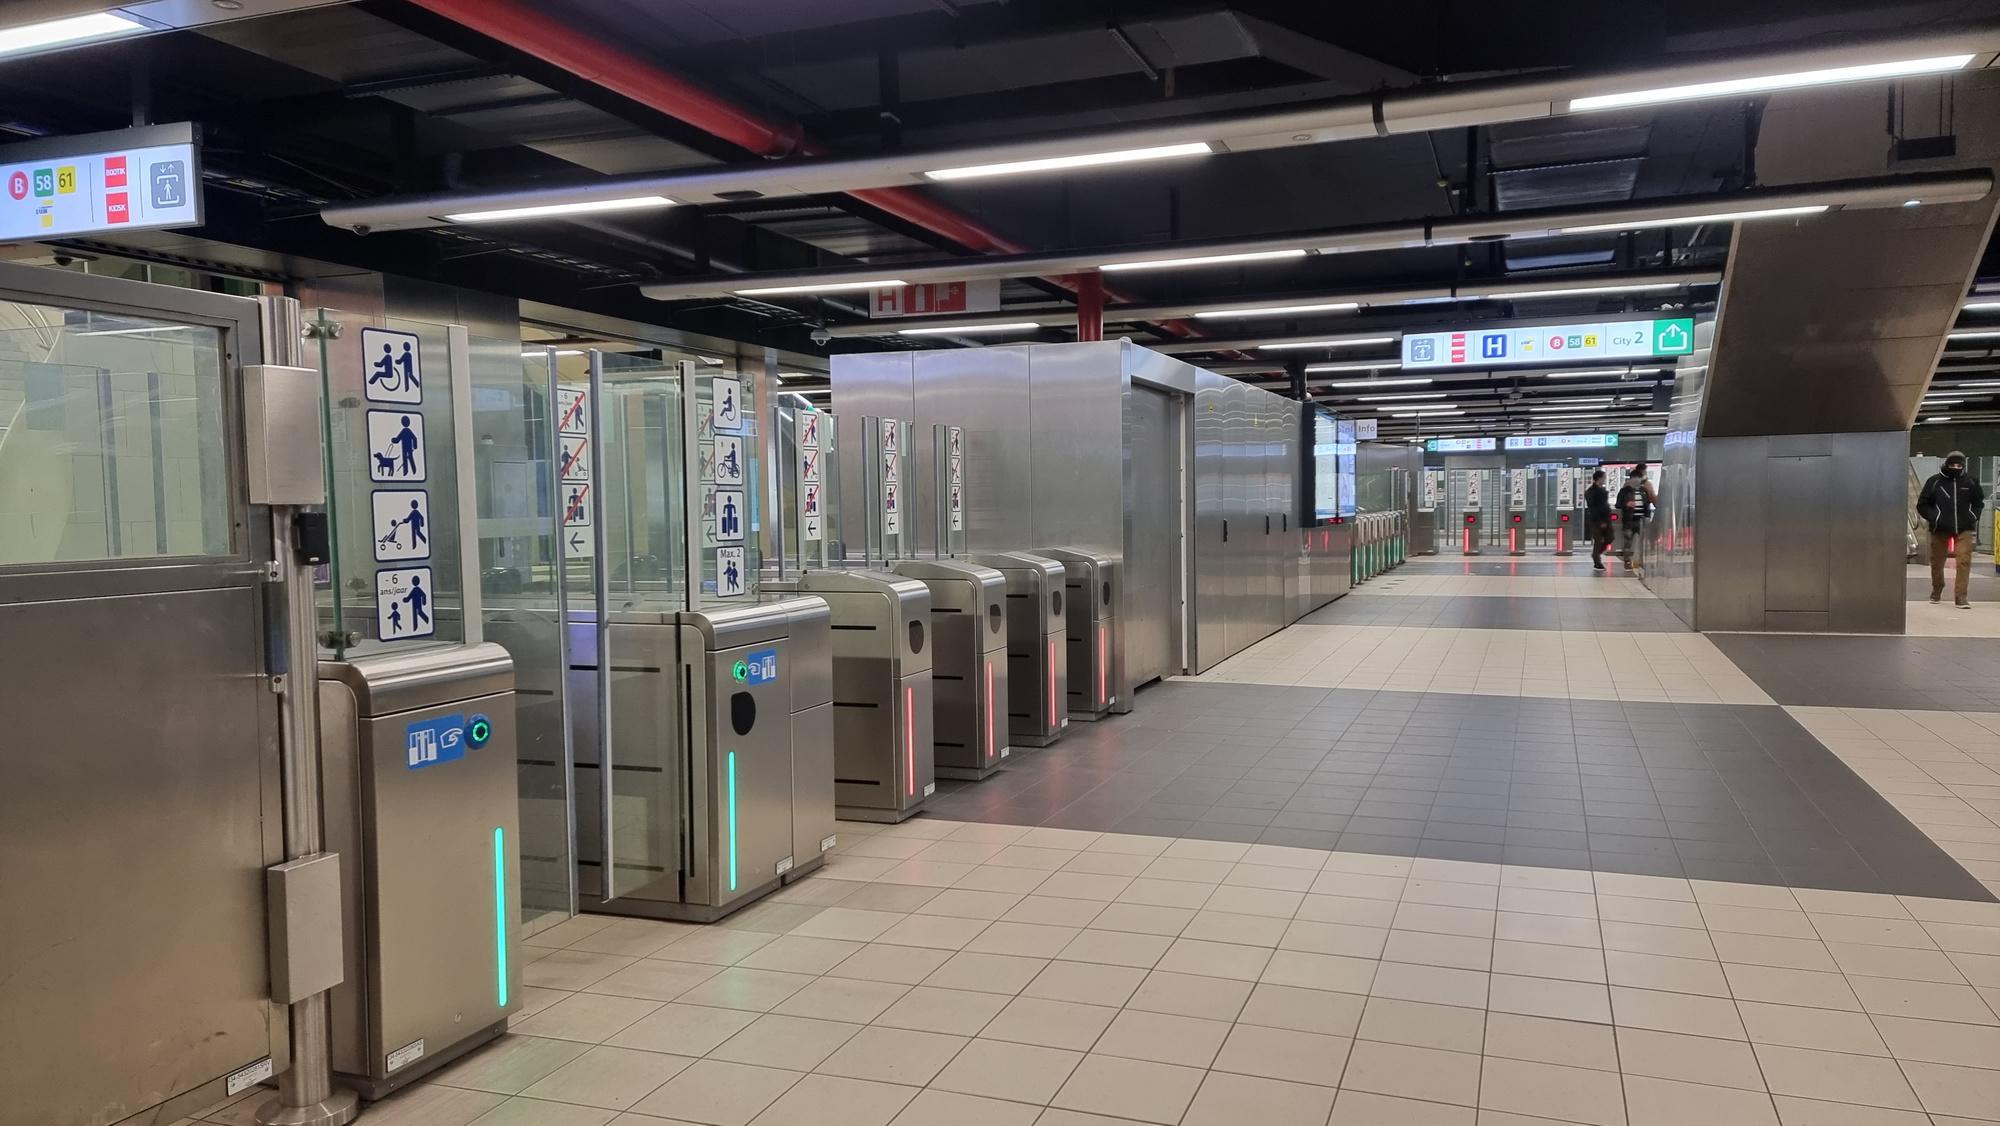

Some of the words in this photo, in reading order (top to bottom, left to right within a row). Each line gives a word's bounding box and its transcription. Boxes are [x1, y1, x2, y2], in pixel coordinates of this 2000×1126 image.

[14, 177, 23, 194] B
[36, 175, 51, 191] 58
[59, 173, 72, 188] 61
[1569, 338, 1581, 346] 58
[1585, 337, 1596, 345] 61
[1613, 336, 1631, 346] City
[1634, 331, 1644, 344] 2
[1487, 337, 1503, 356] H
[1359, 424, 1376, 433] Info
[736, 548, 741, 557] 2
